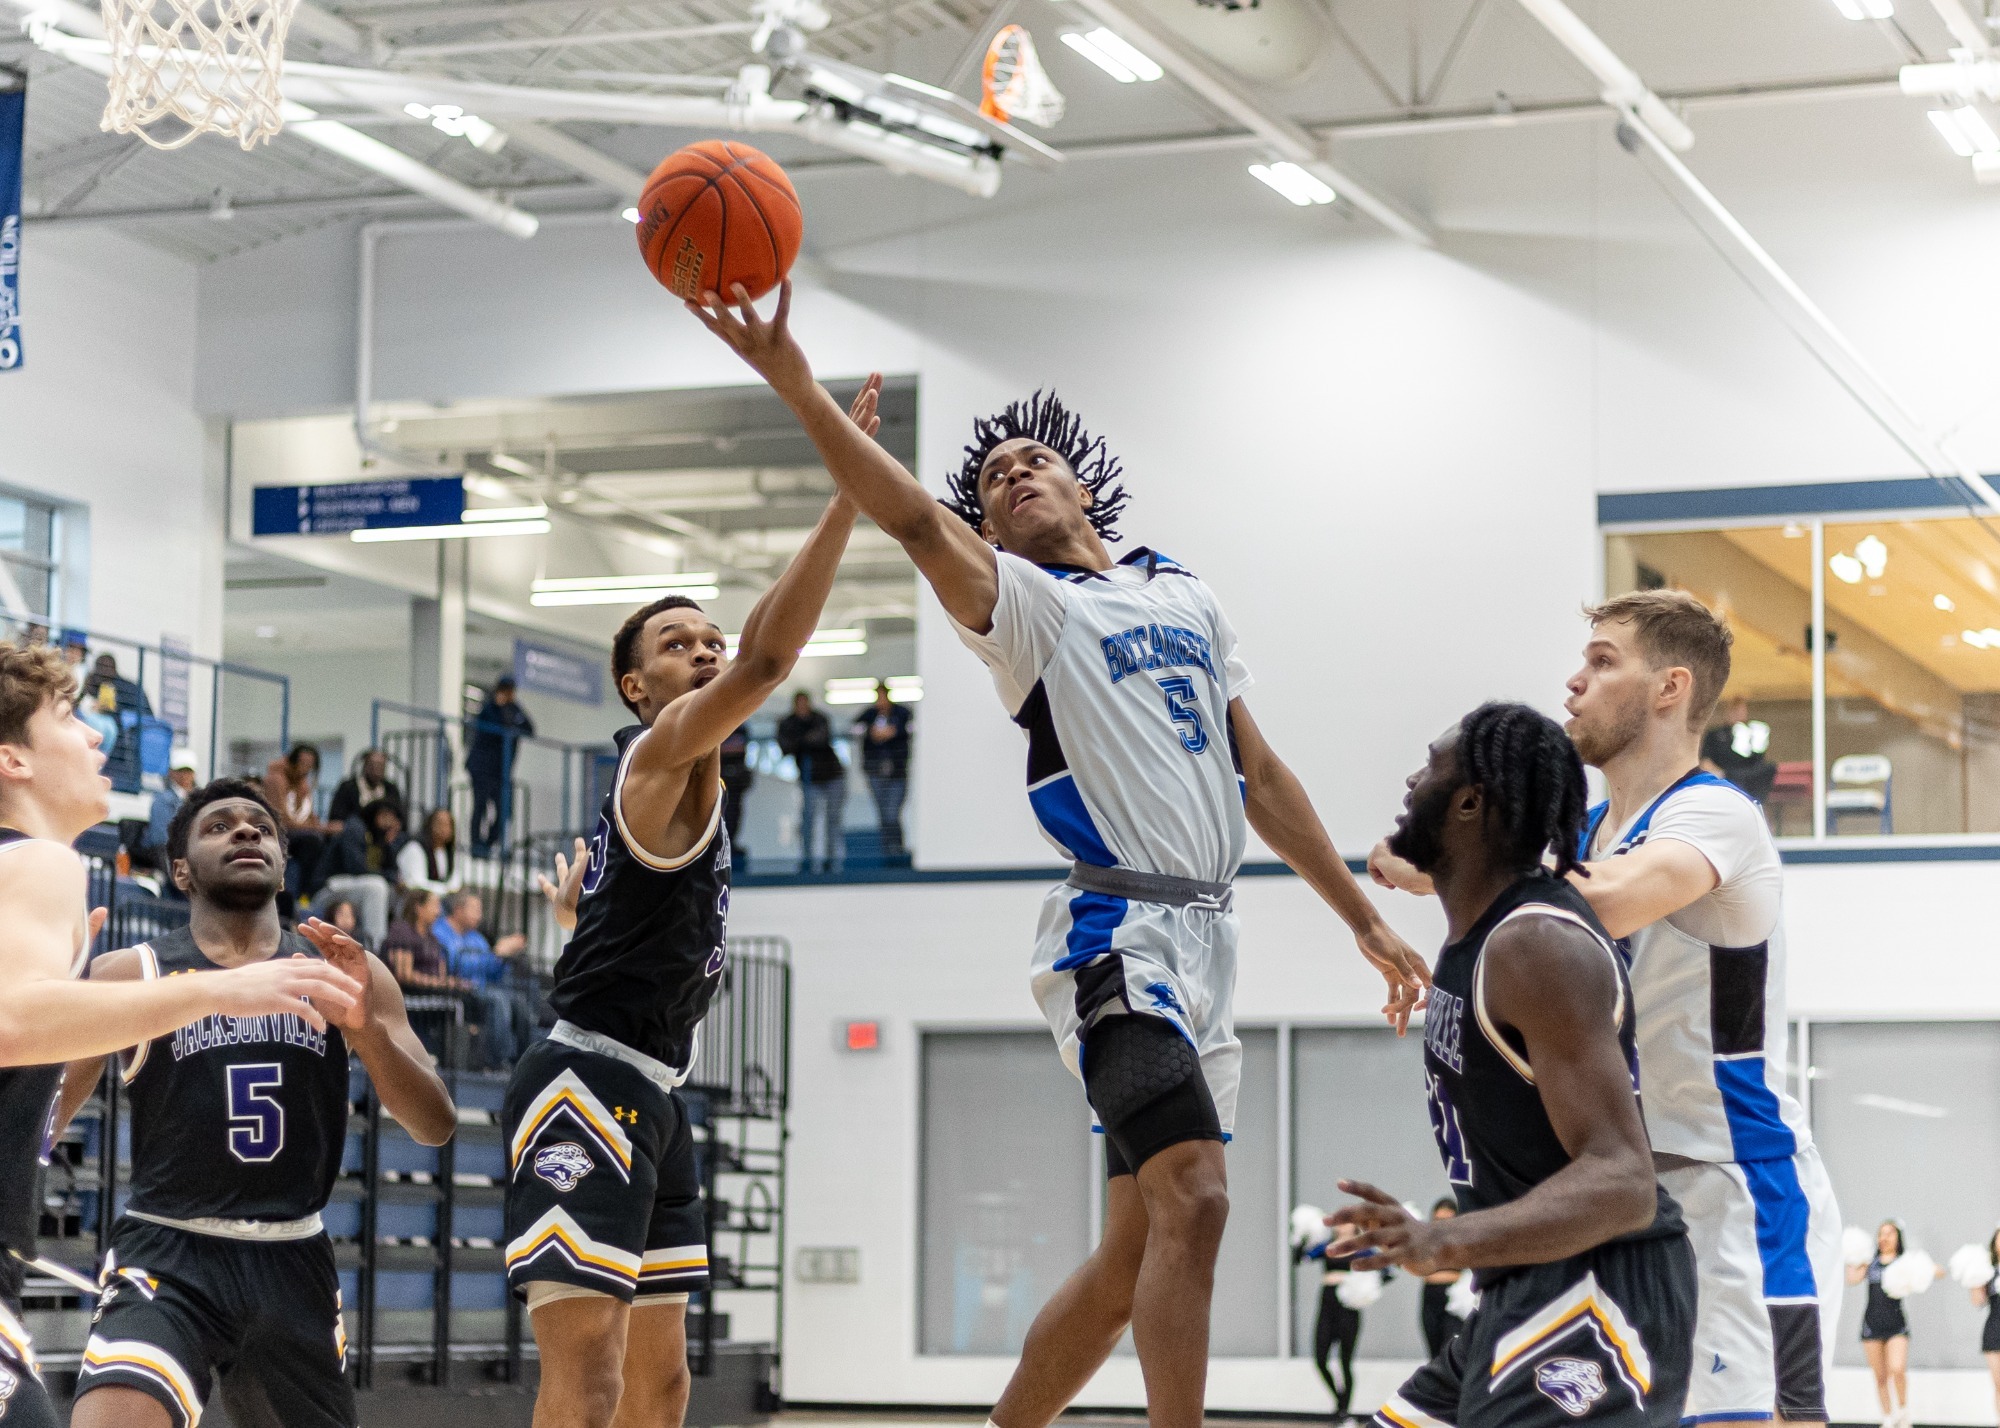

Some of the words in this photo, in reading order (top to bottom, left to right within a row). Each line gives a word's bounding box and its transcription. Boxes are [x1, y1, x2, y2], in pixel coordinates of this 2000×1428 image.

[1156, 675, 1210, 755] 5
[705, 885, 731, 979] 3
[226, 1063, 283, 1163] 5
